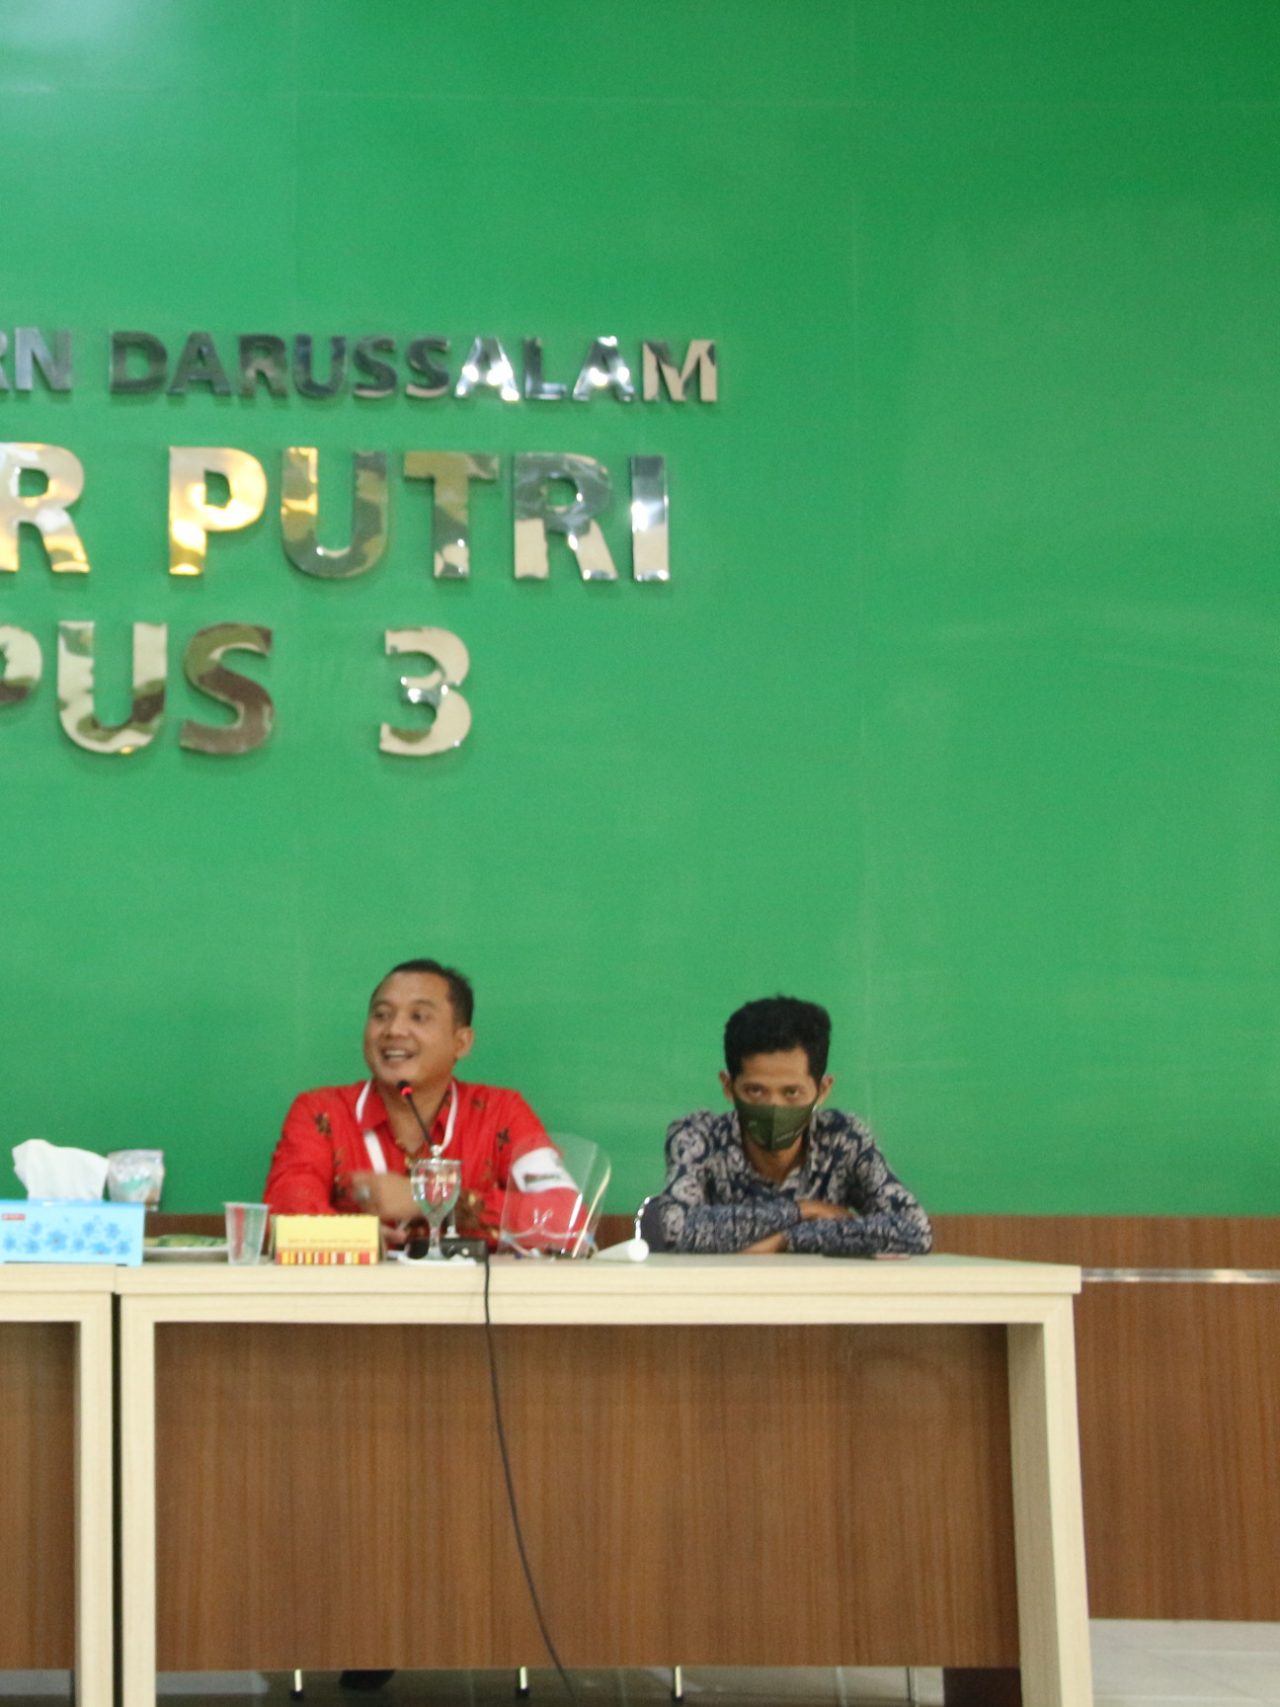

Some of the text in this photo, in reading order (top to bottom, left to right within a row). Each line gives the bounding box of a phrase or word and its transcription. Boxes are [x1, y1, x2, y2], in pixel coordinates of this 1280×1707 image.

[109, 329, 718, 403] DARUSSALAM
[168, 445, 670, 583] PUTRI
[379, 626, 472, 756] 3
